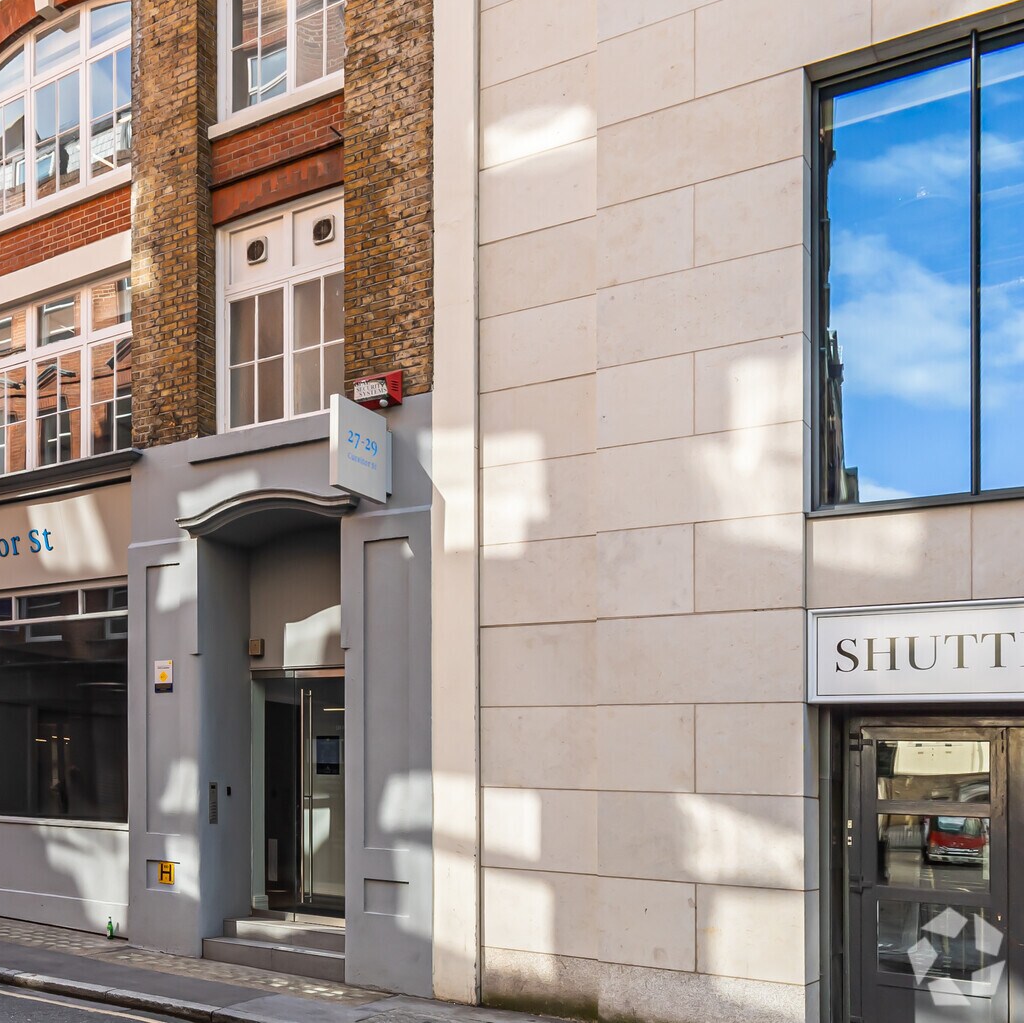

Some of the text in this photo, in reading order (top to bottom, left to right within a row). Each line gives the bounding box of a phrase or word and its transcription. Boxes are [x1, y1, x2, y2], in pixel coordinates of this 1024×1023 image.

[359, 388, 387, 396] SYSTEMS
[348, 430, 377, 456] 27-29
[28, 528, 54, 554] St
[835, 631, 1024, 673] SHUTT
